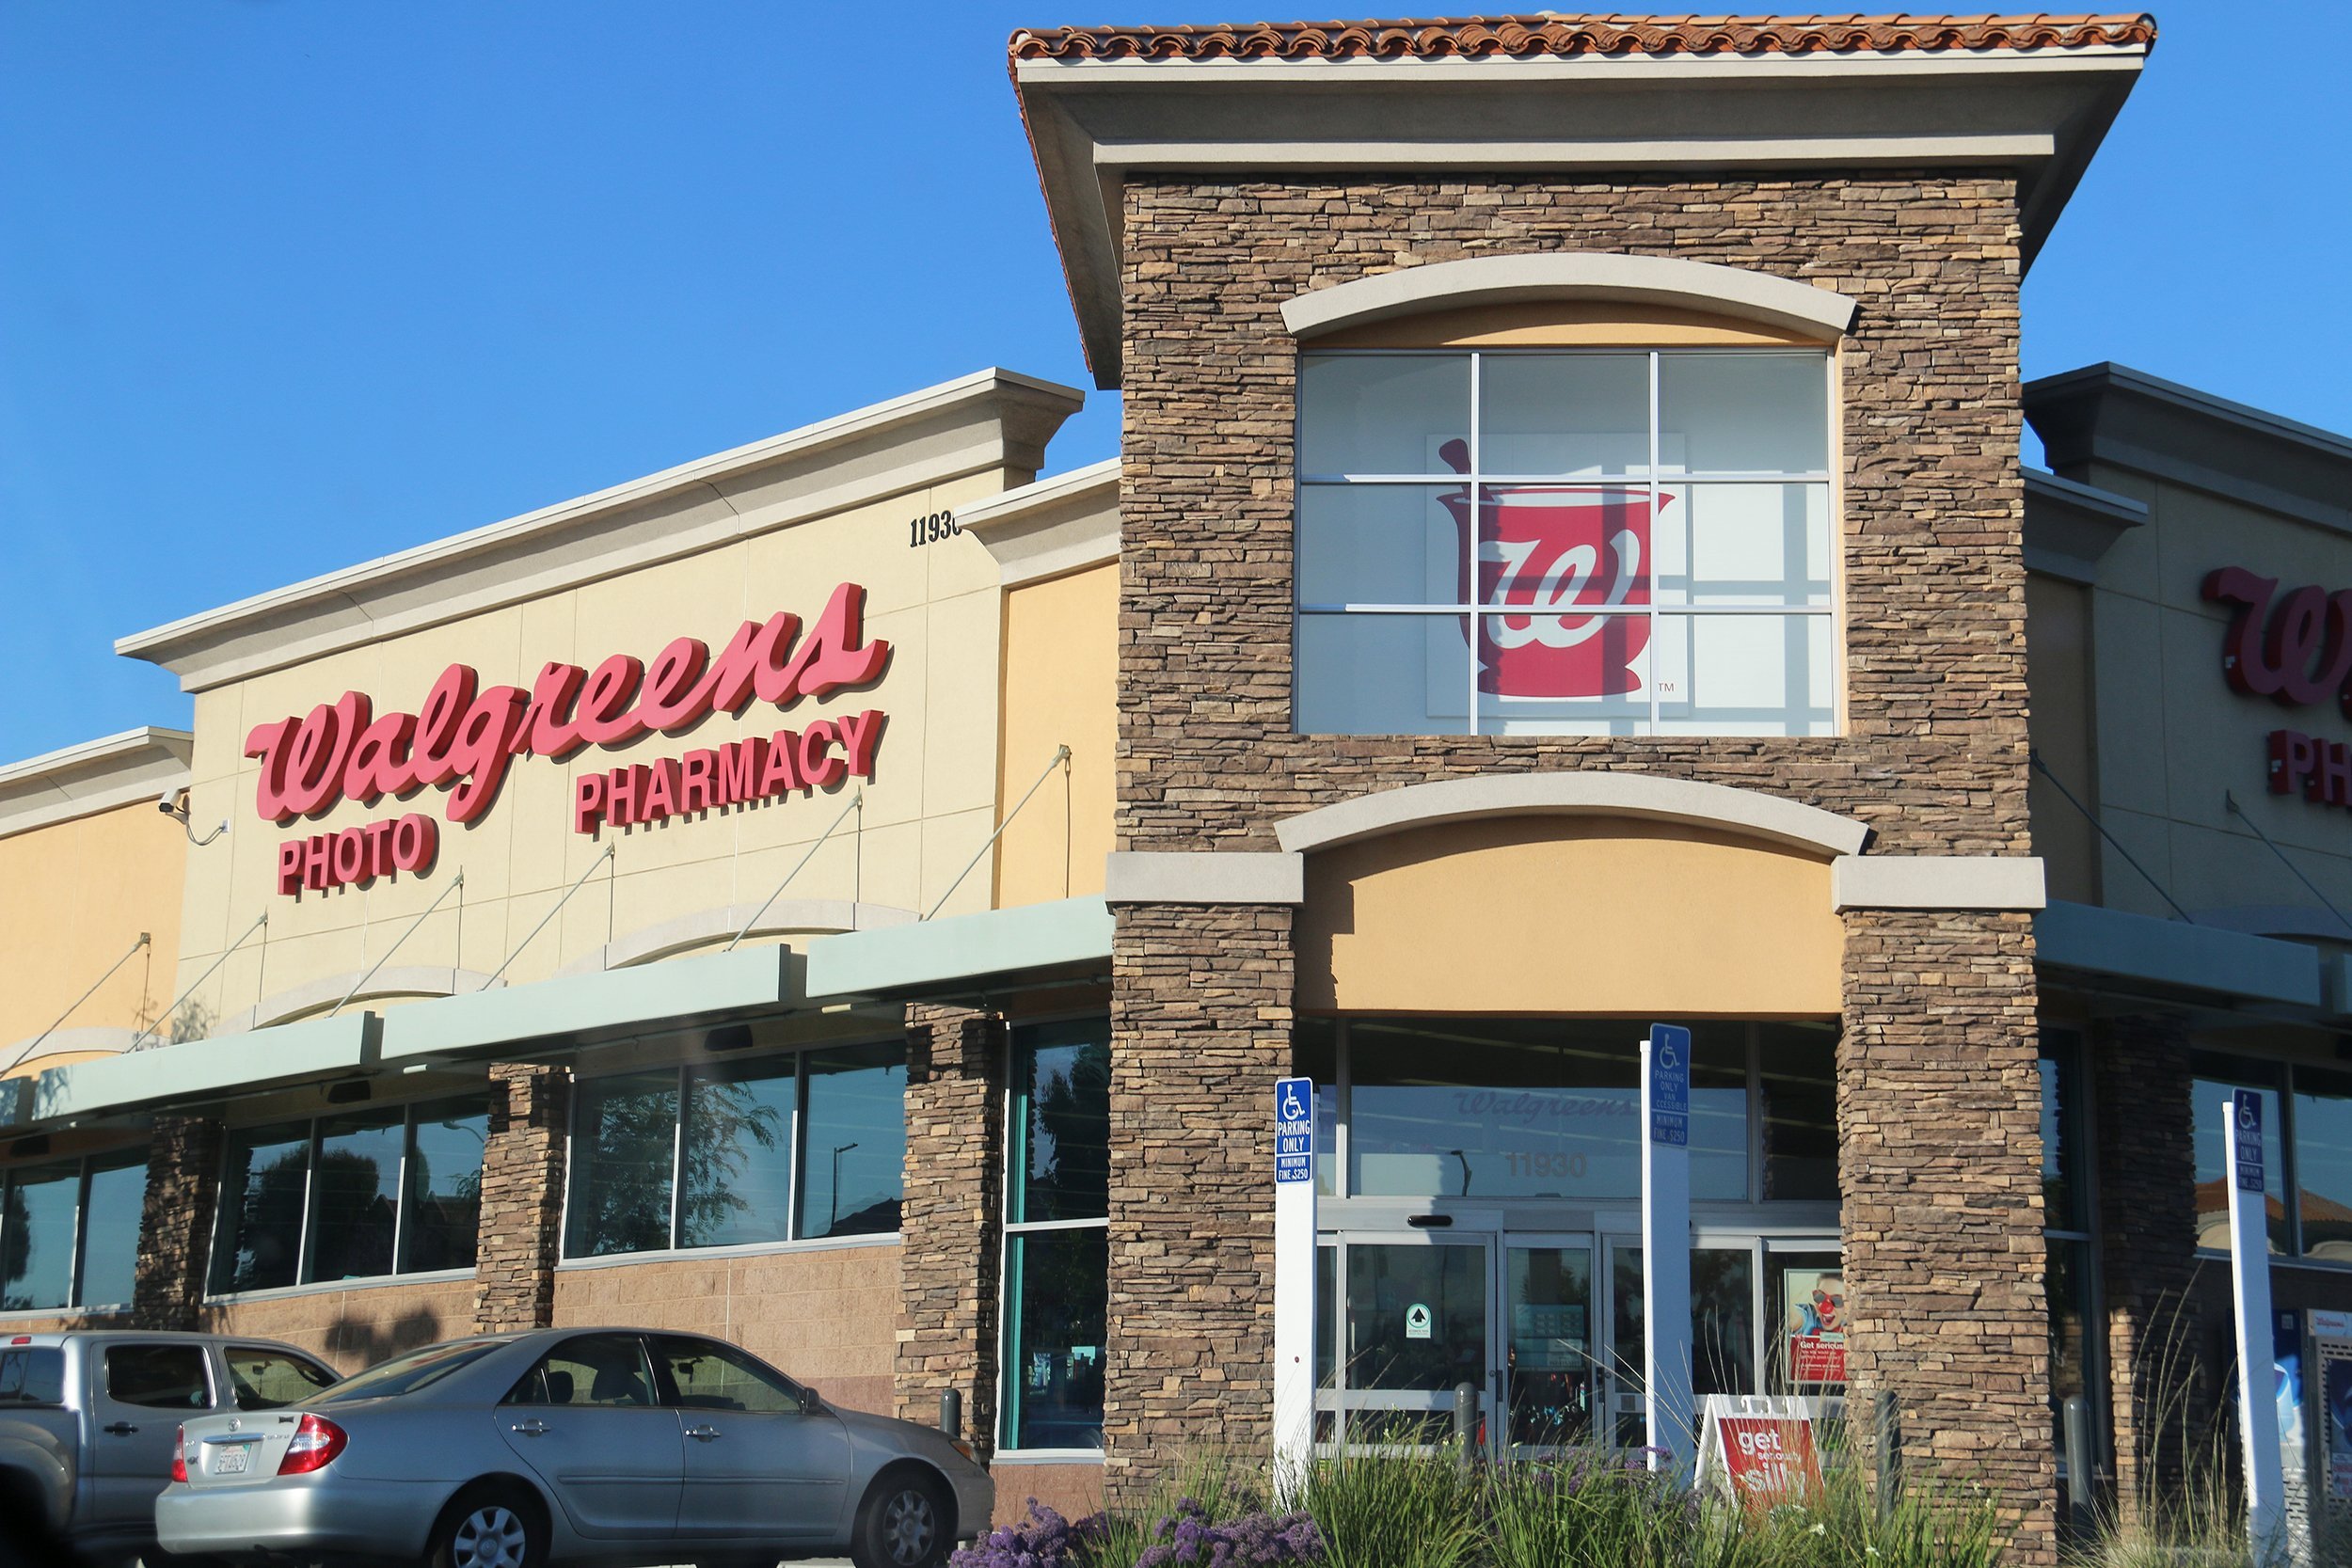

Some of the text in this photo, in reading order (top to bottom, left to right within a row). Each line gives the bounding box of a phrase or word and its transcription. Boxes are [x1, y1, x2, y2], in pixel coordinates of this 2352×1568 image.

[2201, 565, 2352, 705] W
[1658, 682, 1675, 692] TM
[245, 581, 890, 824] Walgreens
[575, 709, 885, 835] PHARMACY
[277, 813, 437, 895] PHOTO
[1655, 1069, 1684, 1083] PARKING
[1660, 1081, 1678, 1092] ONLY
[1663, 1092, 1677, 1101] VAN
[1454, 1091, 1638, 1125] Walgreens
[1278, 1119, 1311, 1136] PARKING
[1656, 1114, 1683, 1127] MINIMUM
[1654, 1127, 1685, 1143] FINE $250
[1282, 1137, 1305, 1153] ONLY
[1280, 1155, 1306, 1168] MINIMUM
[2240, 1146, 2257, 1162] ONLY
[1506, 1151, 1588, 1177] 11930
[1279, 1168, 1309, 1180] FINE $250
[1800, 1340, 1814, 1349] Get
[1738, 1428, 1781, 1455] get
